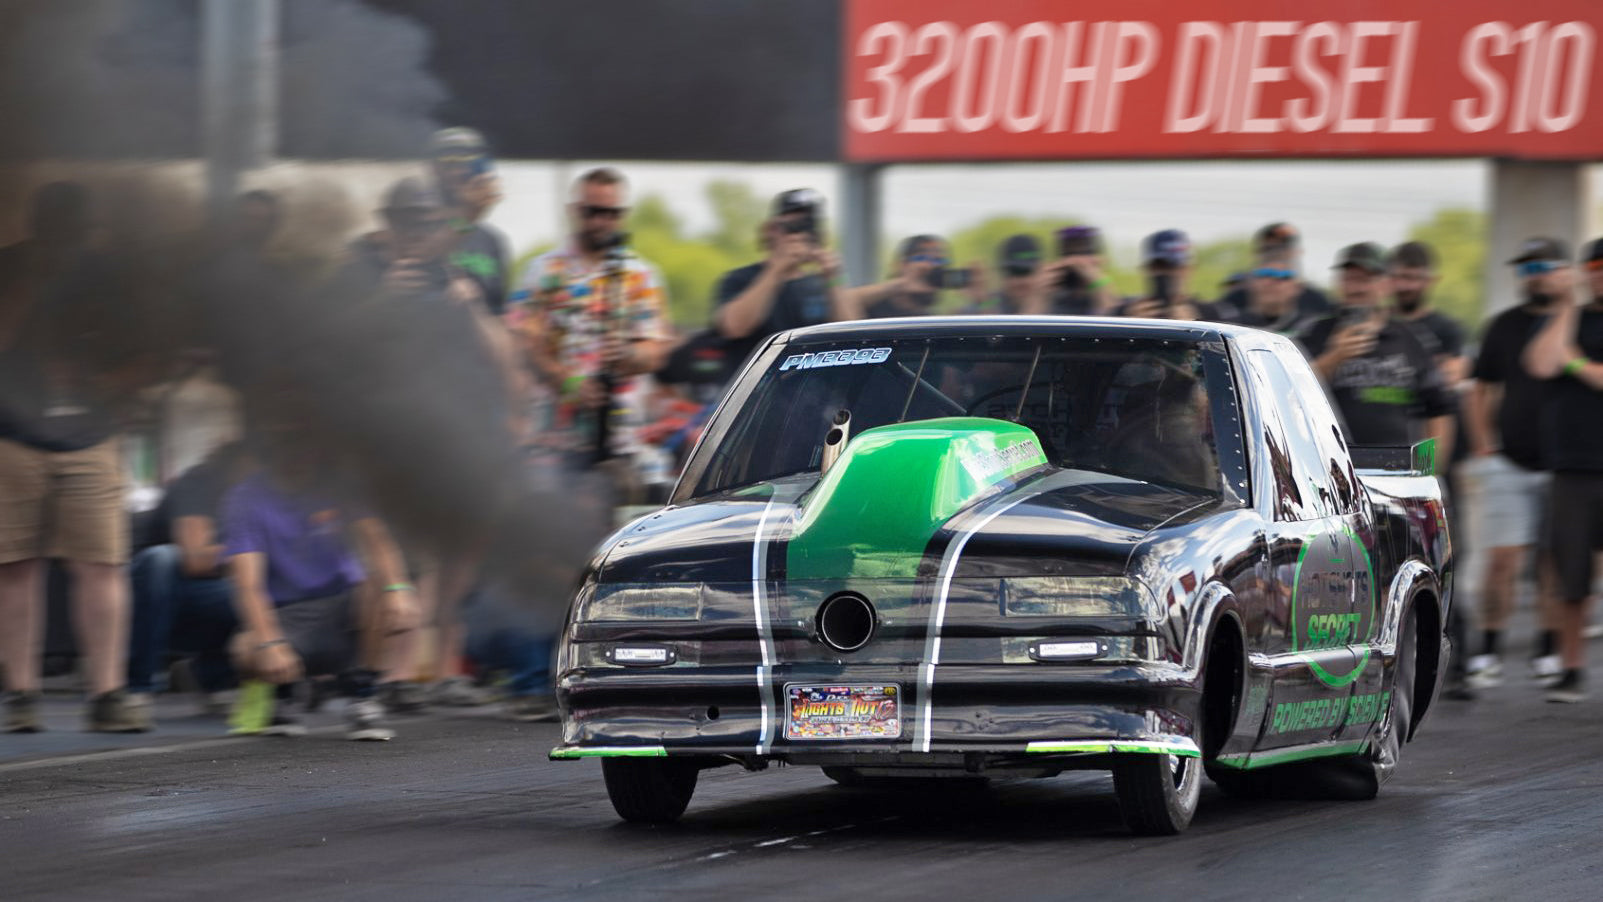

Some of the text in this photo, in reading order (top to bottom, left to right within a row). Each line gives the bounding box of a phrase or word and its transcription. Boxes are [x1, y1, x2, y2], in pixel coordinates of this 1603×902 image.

[847, 20, 1598, 134] 3200HP DIESEL S10
[1307, 612, 1361, 641] SECRET
[1274, 700, 1329, 733] POWERED
[1327, 696, 1348, 727] BY
[1348, 691, 1391, 726] SCIENE
